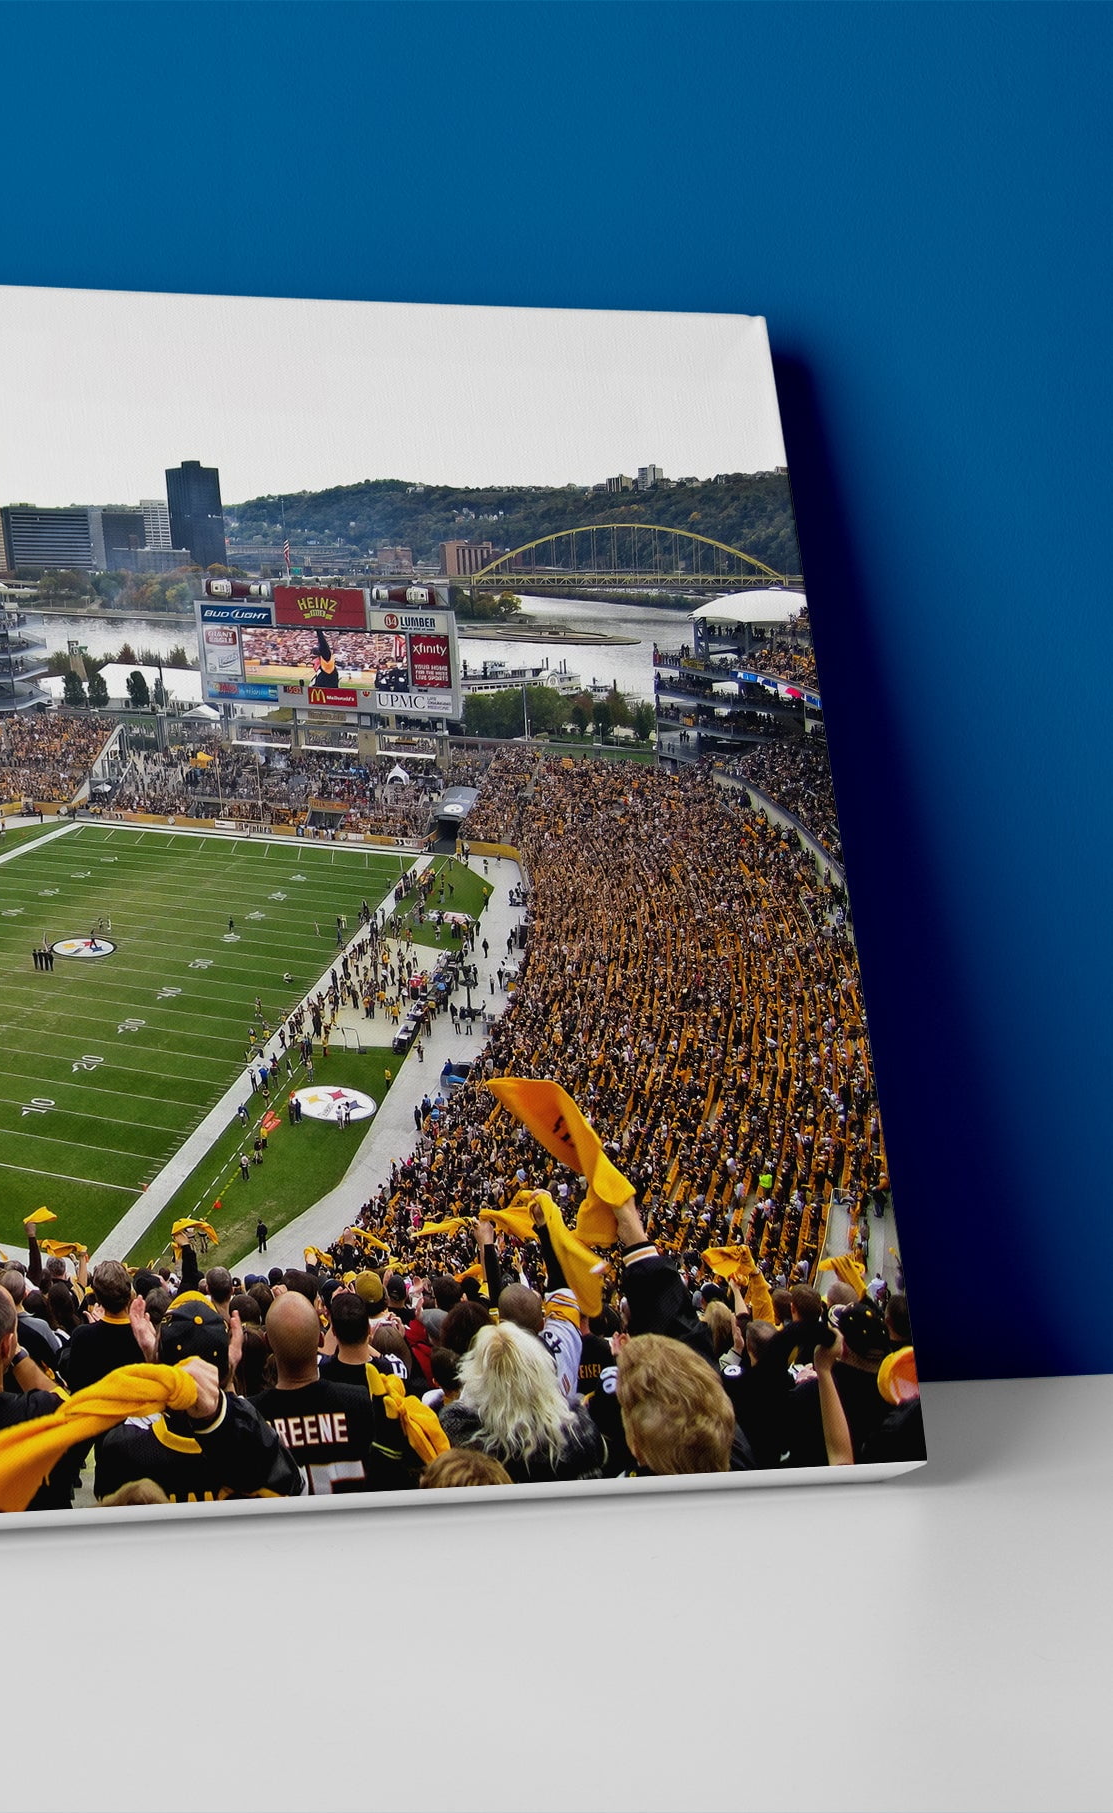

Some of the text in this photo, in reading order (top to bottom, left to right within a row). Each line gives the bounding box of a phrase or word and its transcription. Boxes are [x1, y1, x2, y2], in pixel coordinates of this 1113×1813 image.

[297, 597, 338, 612] HEINZ
[204, 609, 268, 619] BUD LIGHT
[400, 617, 436, 628] LUMBER
[413, 643, 447, 656] xfinity
[378, 693, 425, 709] UPMC
[117, 1018, 146, 1031] 30
[72, 1055, 104, 1070] 20
[22, 1098, 56, 1113] 10
[266, 1412, 349, 1450] REENE
